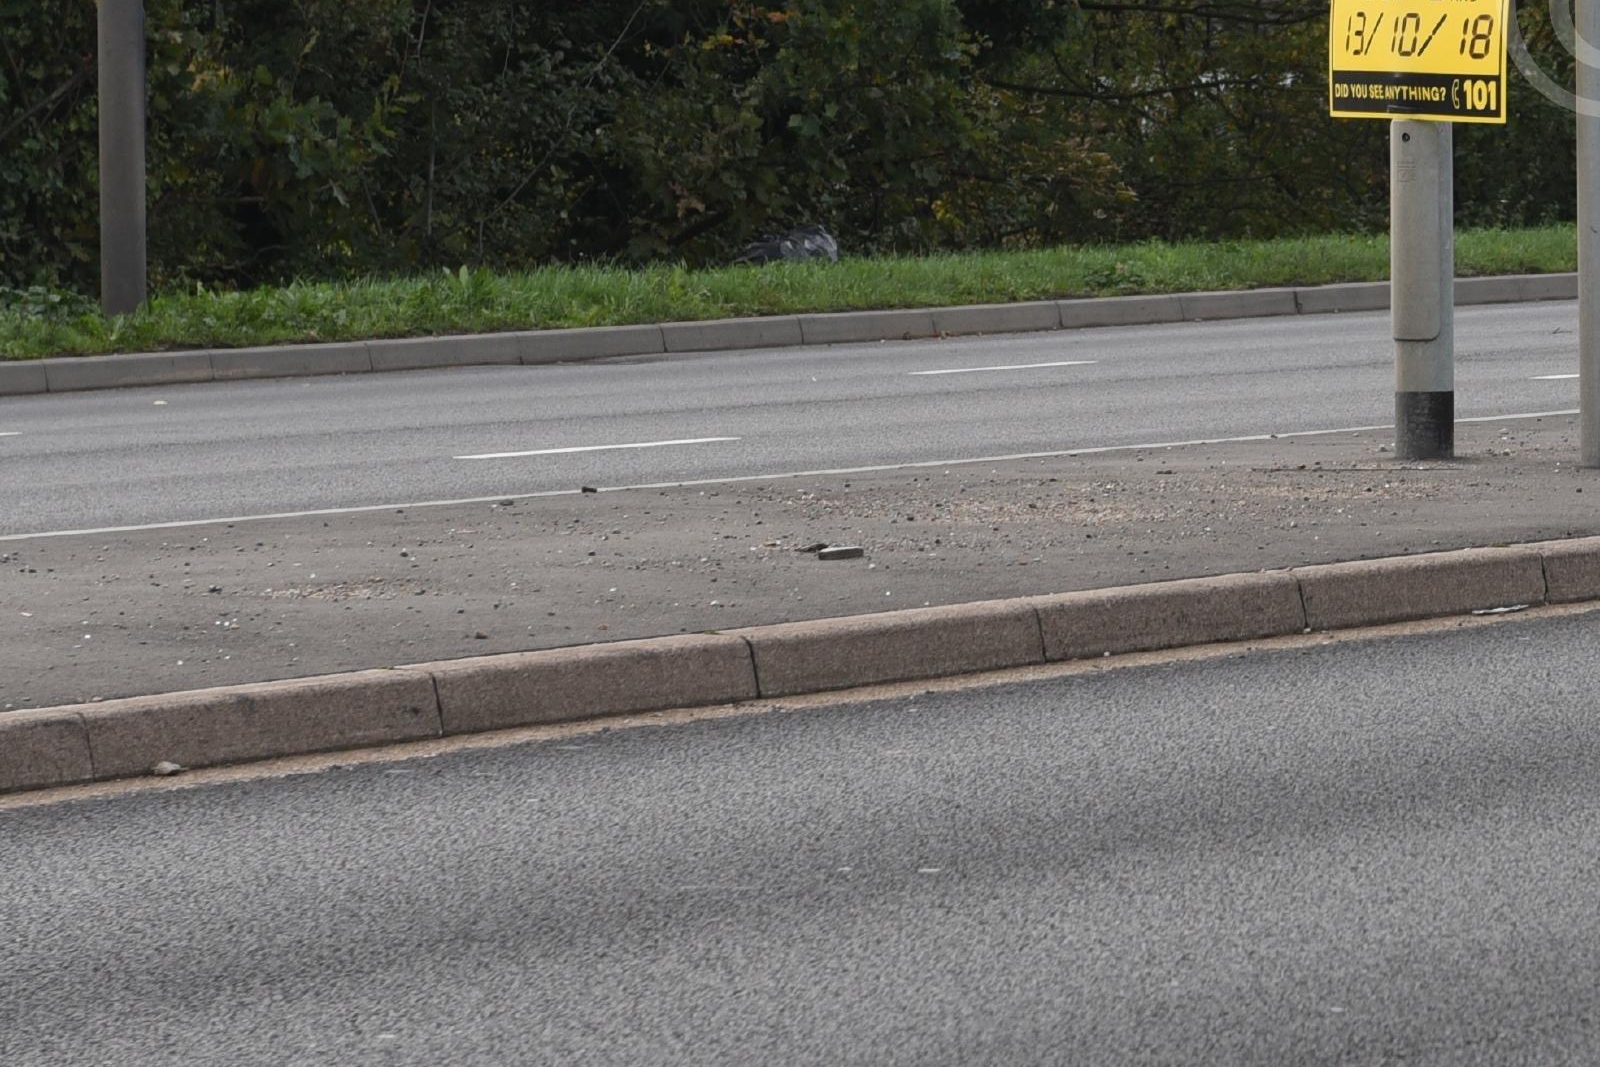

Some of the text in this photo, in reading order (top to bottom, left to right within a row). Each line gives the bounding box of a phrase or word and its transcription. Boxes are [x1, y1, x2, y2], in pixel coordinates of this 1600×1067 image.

[1334, 83, 1448, 102] DID YOU SEE ANYTHING?
[1462, 79, 1498, 111] 101
